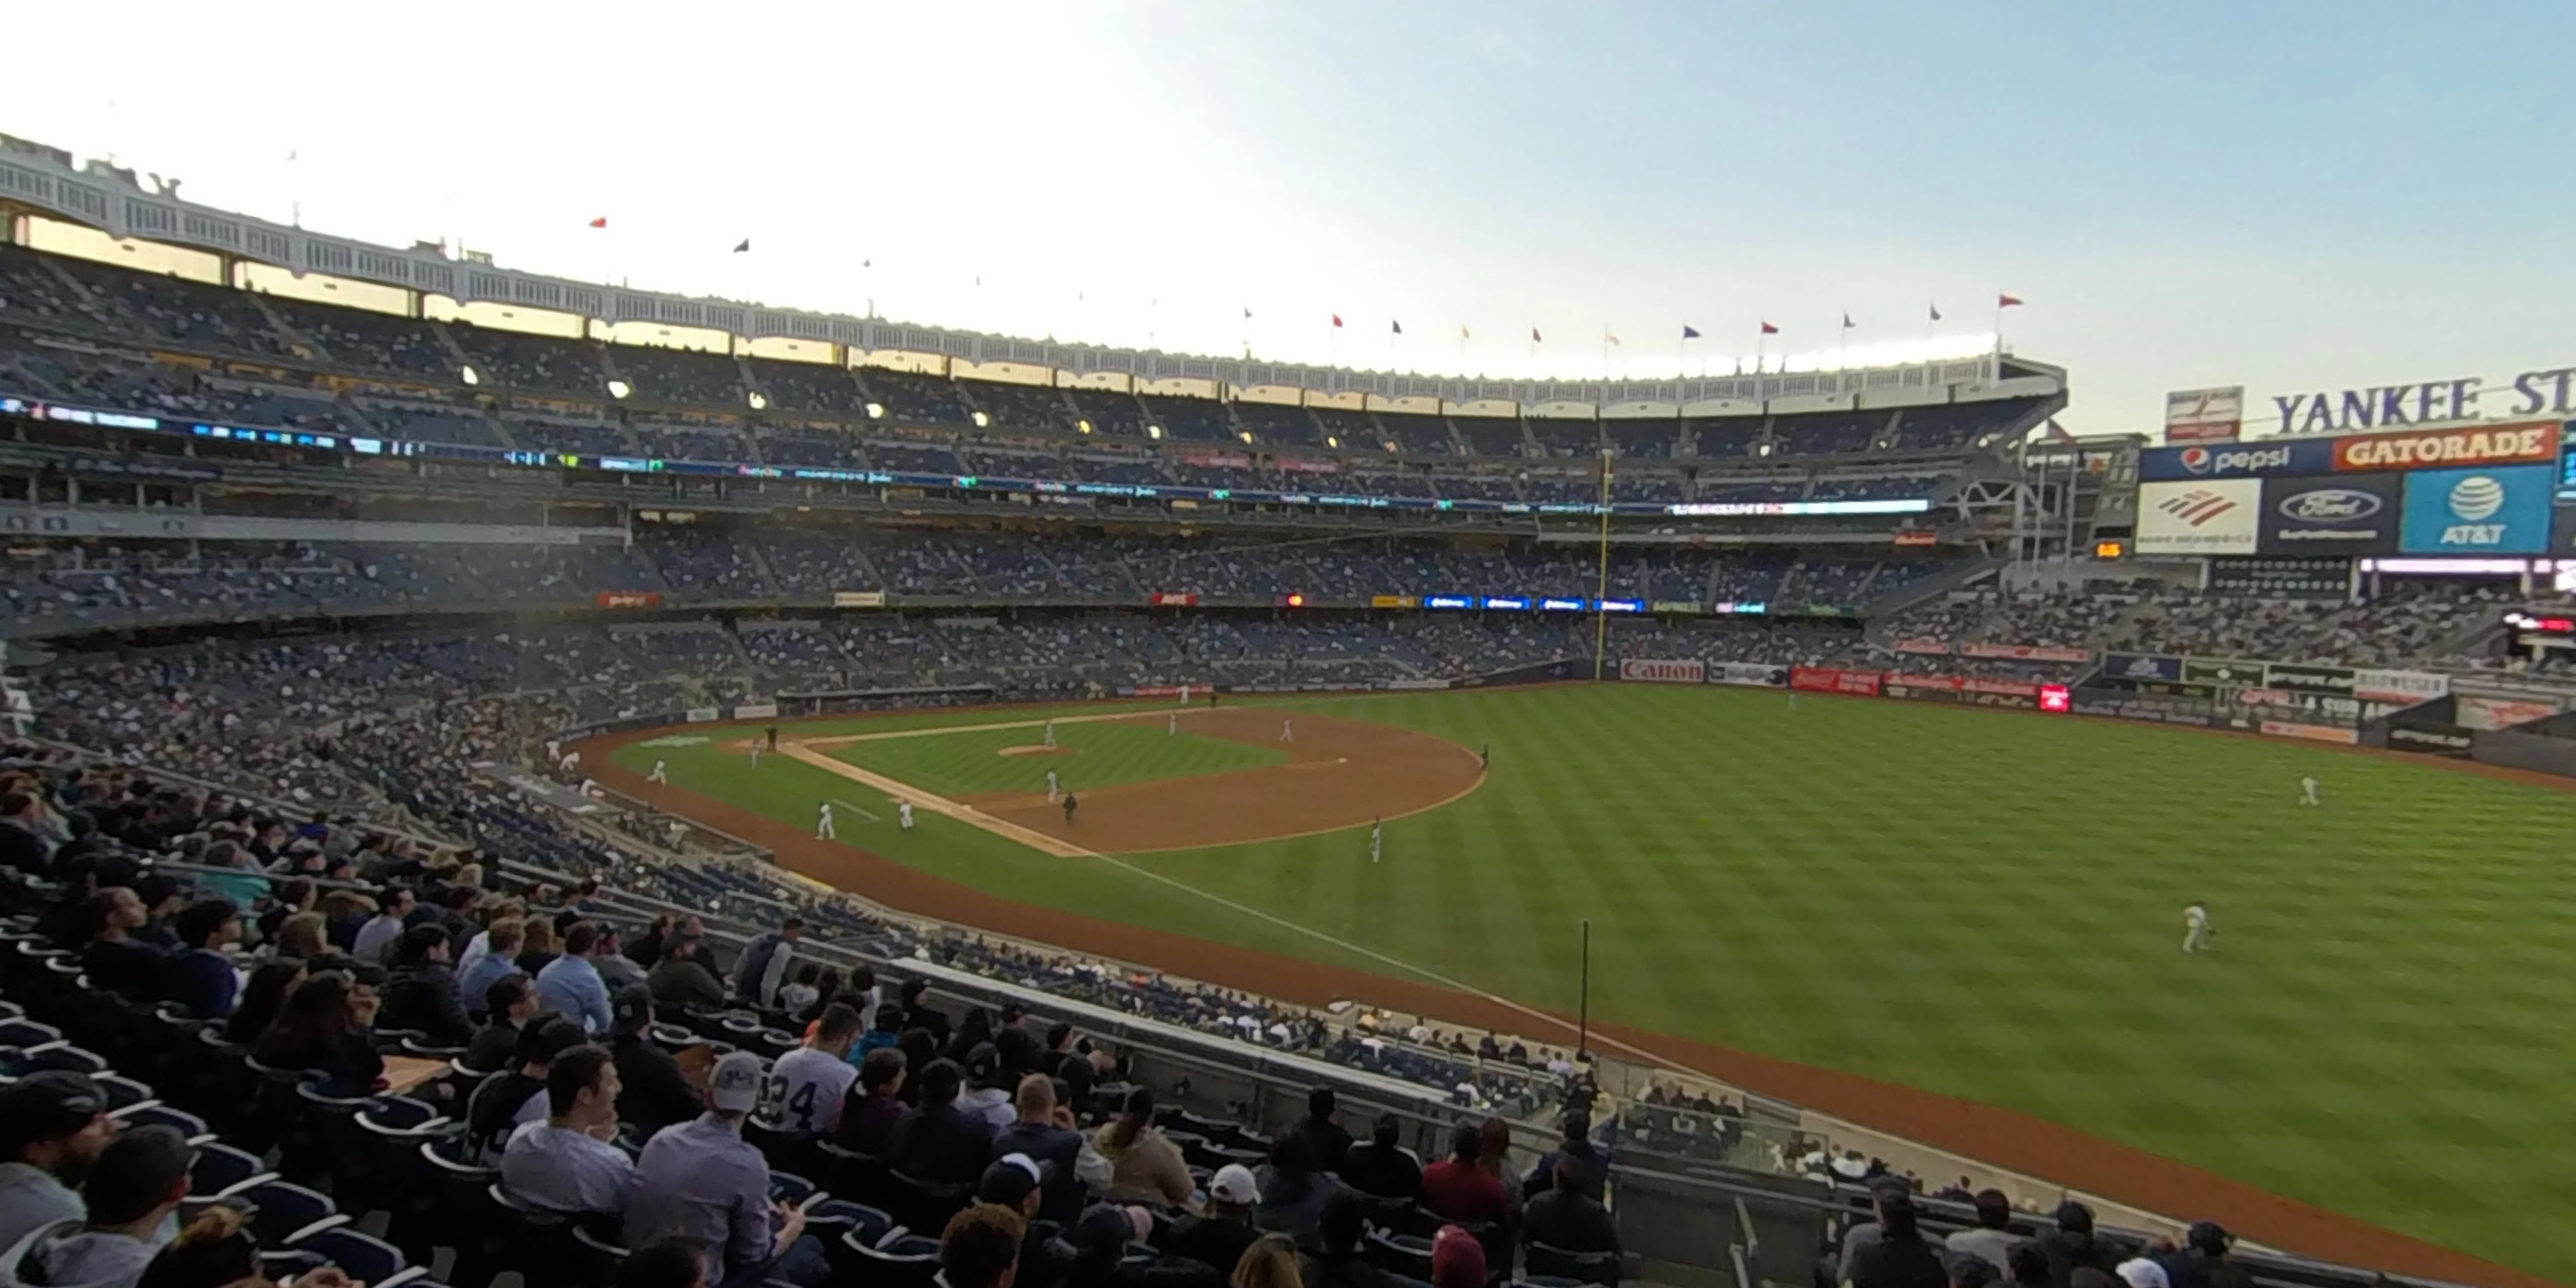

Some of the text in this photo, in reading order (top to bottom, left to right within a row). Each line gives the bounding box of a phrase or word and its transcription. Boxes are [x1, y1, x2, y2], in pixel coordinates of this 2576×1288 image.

[2272, 377, 2482, 433] YANKEE
[2215, 446, 2290, 474] pepsi
[2345, 429, 2546, 466] GATORADE
[2298, 494, 2361, 516] Ford
[2439, 524, 2508, 544] AT&T
[1623, 661, 1702, 679] Canon
